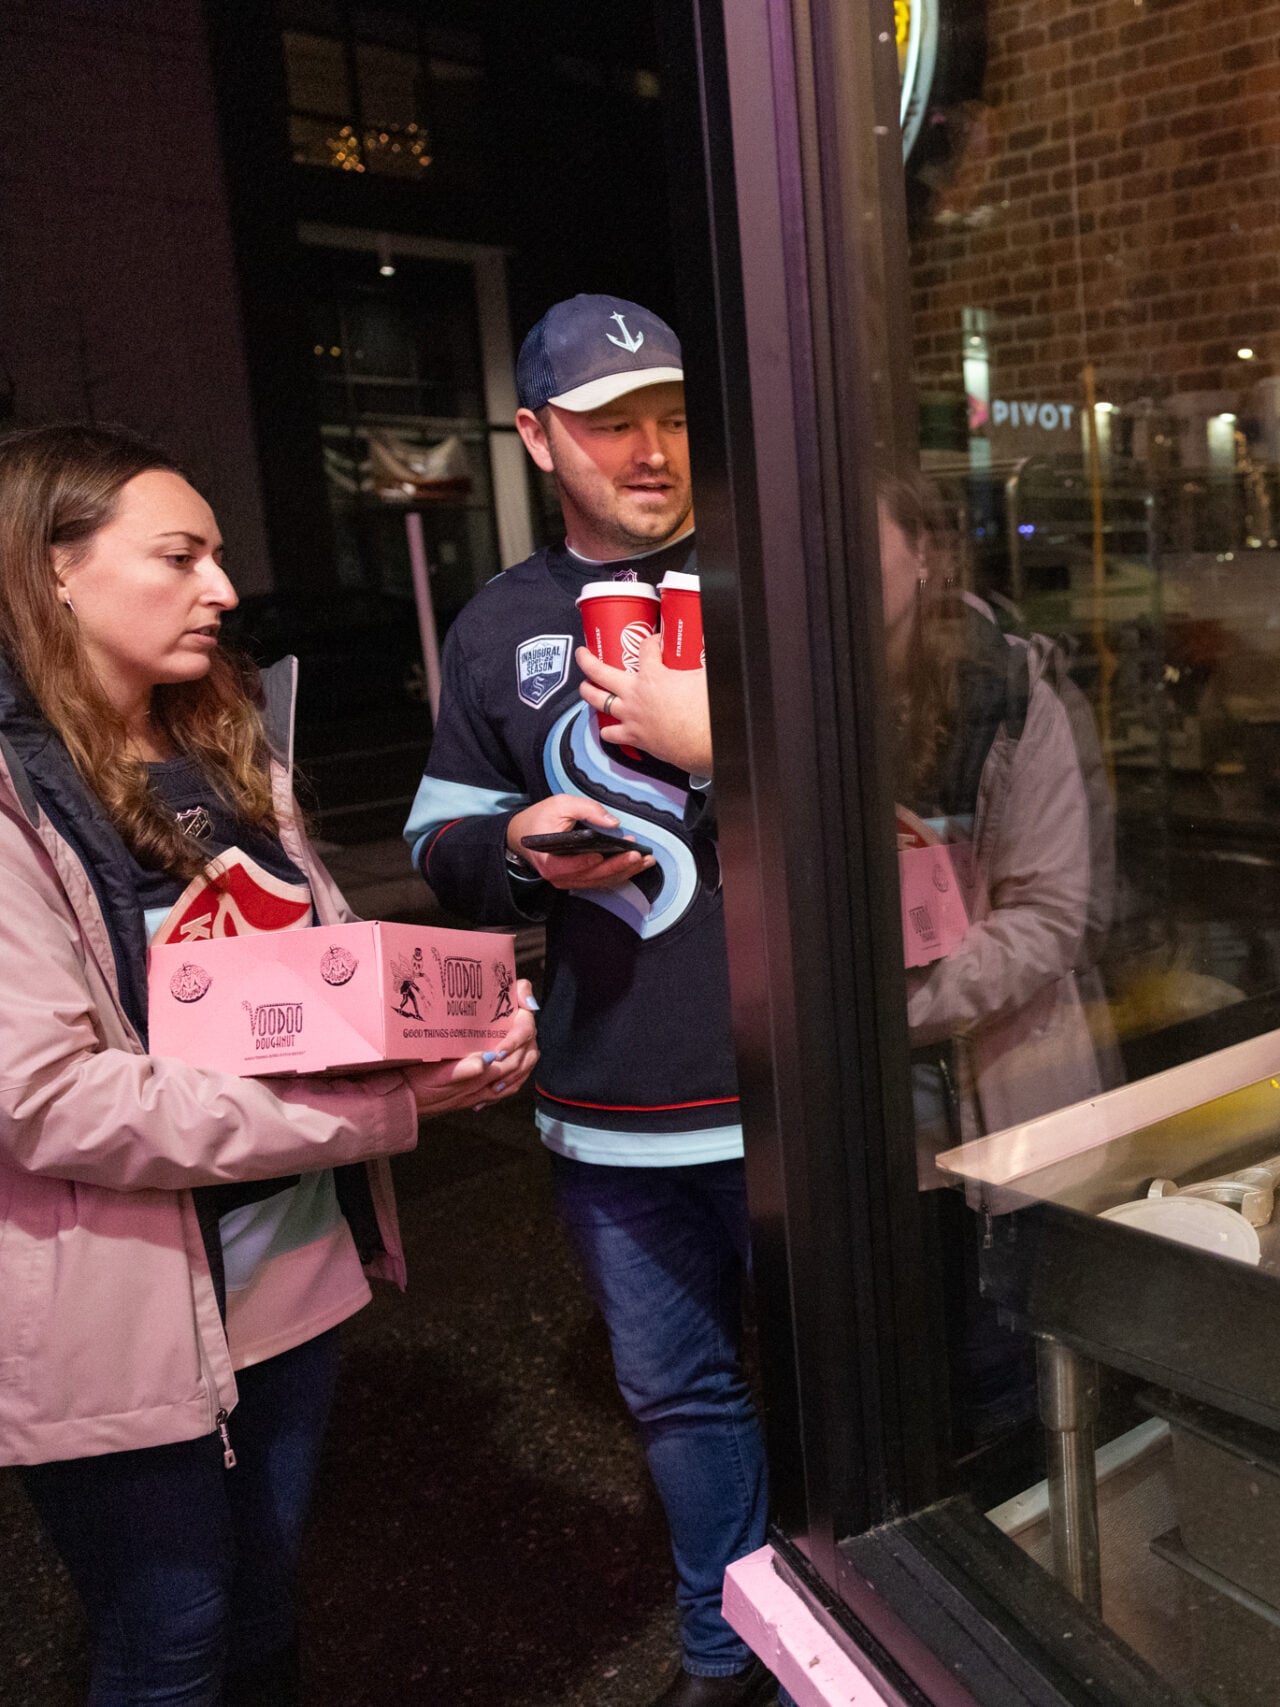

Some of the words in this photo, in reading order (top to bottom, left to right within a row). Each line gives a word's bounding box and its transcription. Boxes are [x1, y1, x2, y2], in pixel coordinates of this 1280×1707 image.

[992, 400, 1073, 430] PIVOT
[521, 645, 561, 664] INAUGURAL
[527, 661, 554, 676] SEASON
[431, 947, 482, 999] VOODOO
[446, 1000, 478, 1016] DOUGHNUT
[242, 1000, 303, 1036] VOODOO
[255, 1034, 296, 1050] DOUGHNUT
[403, 1029, 423, 1038] GOOD
[424, 1029, 449, 1038] THINGS
[449, 1029, 467, 1038] COME
